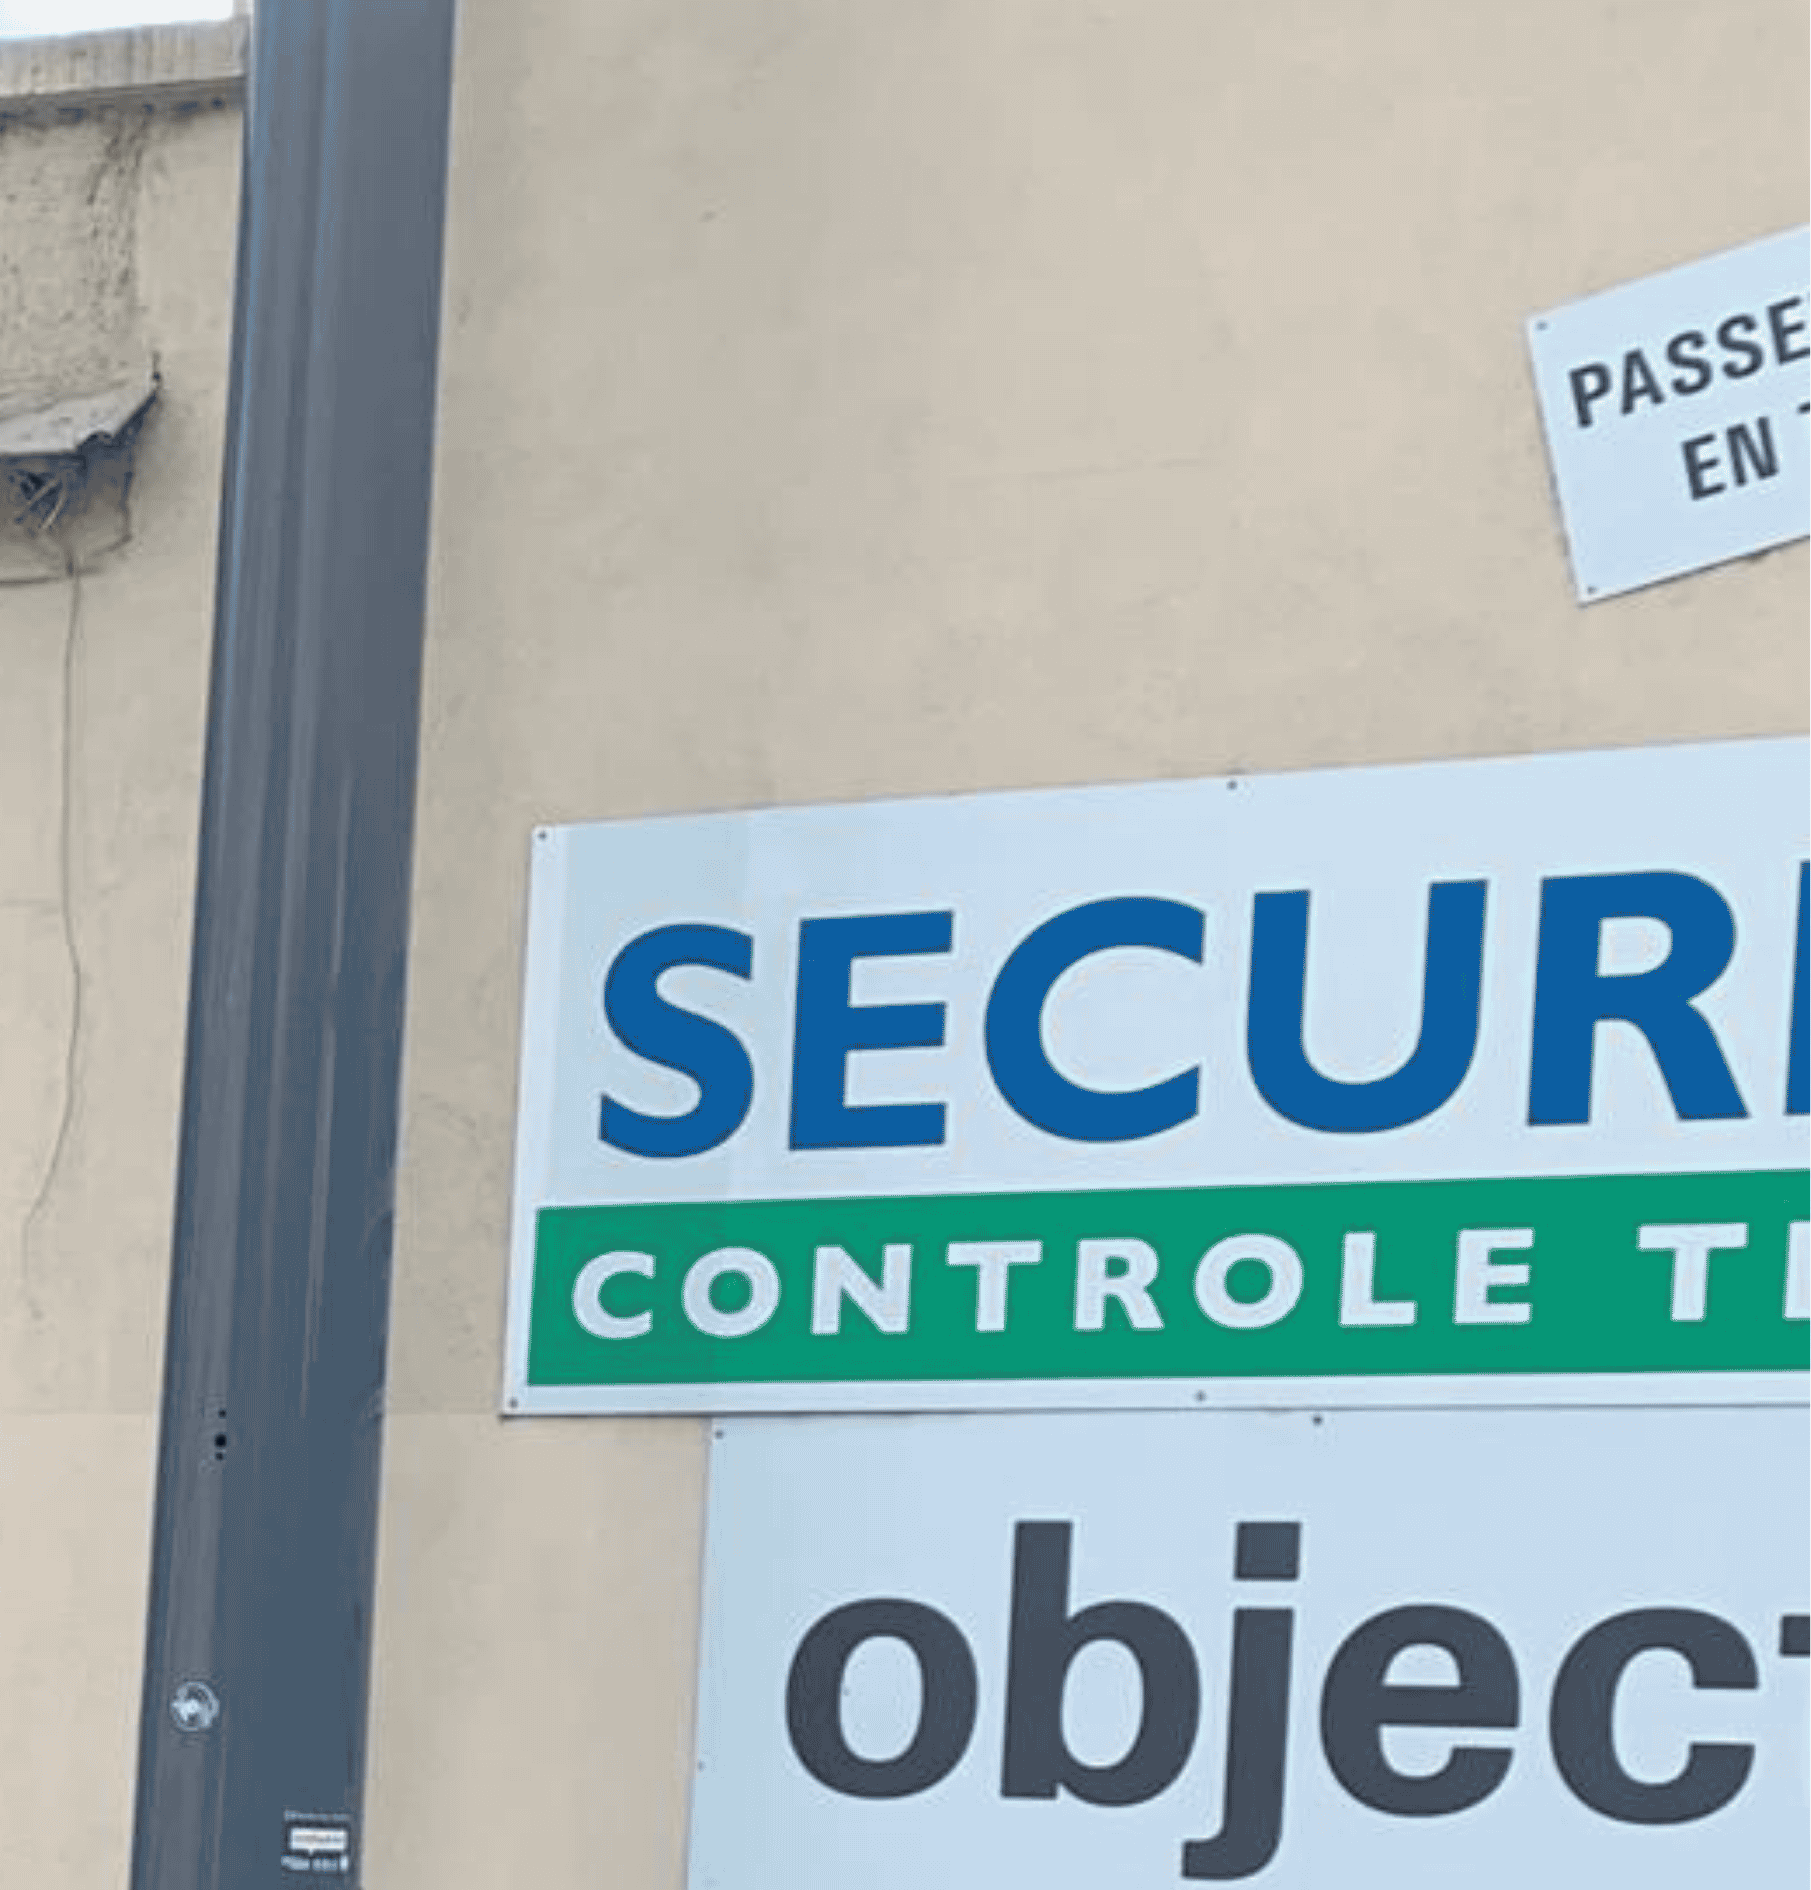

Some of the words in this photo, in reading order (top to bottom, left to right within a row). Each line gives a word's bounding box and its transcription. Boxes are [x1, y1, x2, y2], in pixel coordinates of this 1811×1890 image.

[1568, 295, 1811, 429] PASSE
[1681, 416, 1780, 501] EN
[573, 1228, 1535, 1340] CONTROLE
